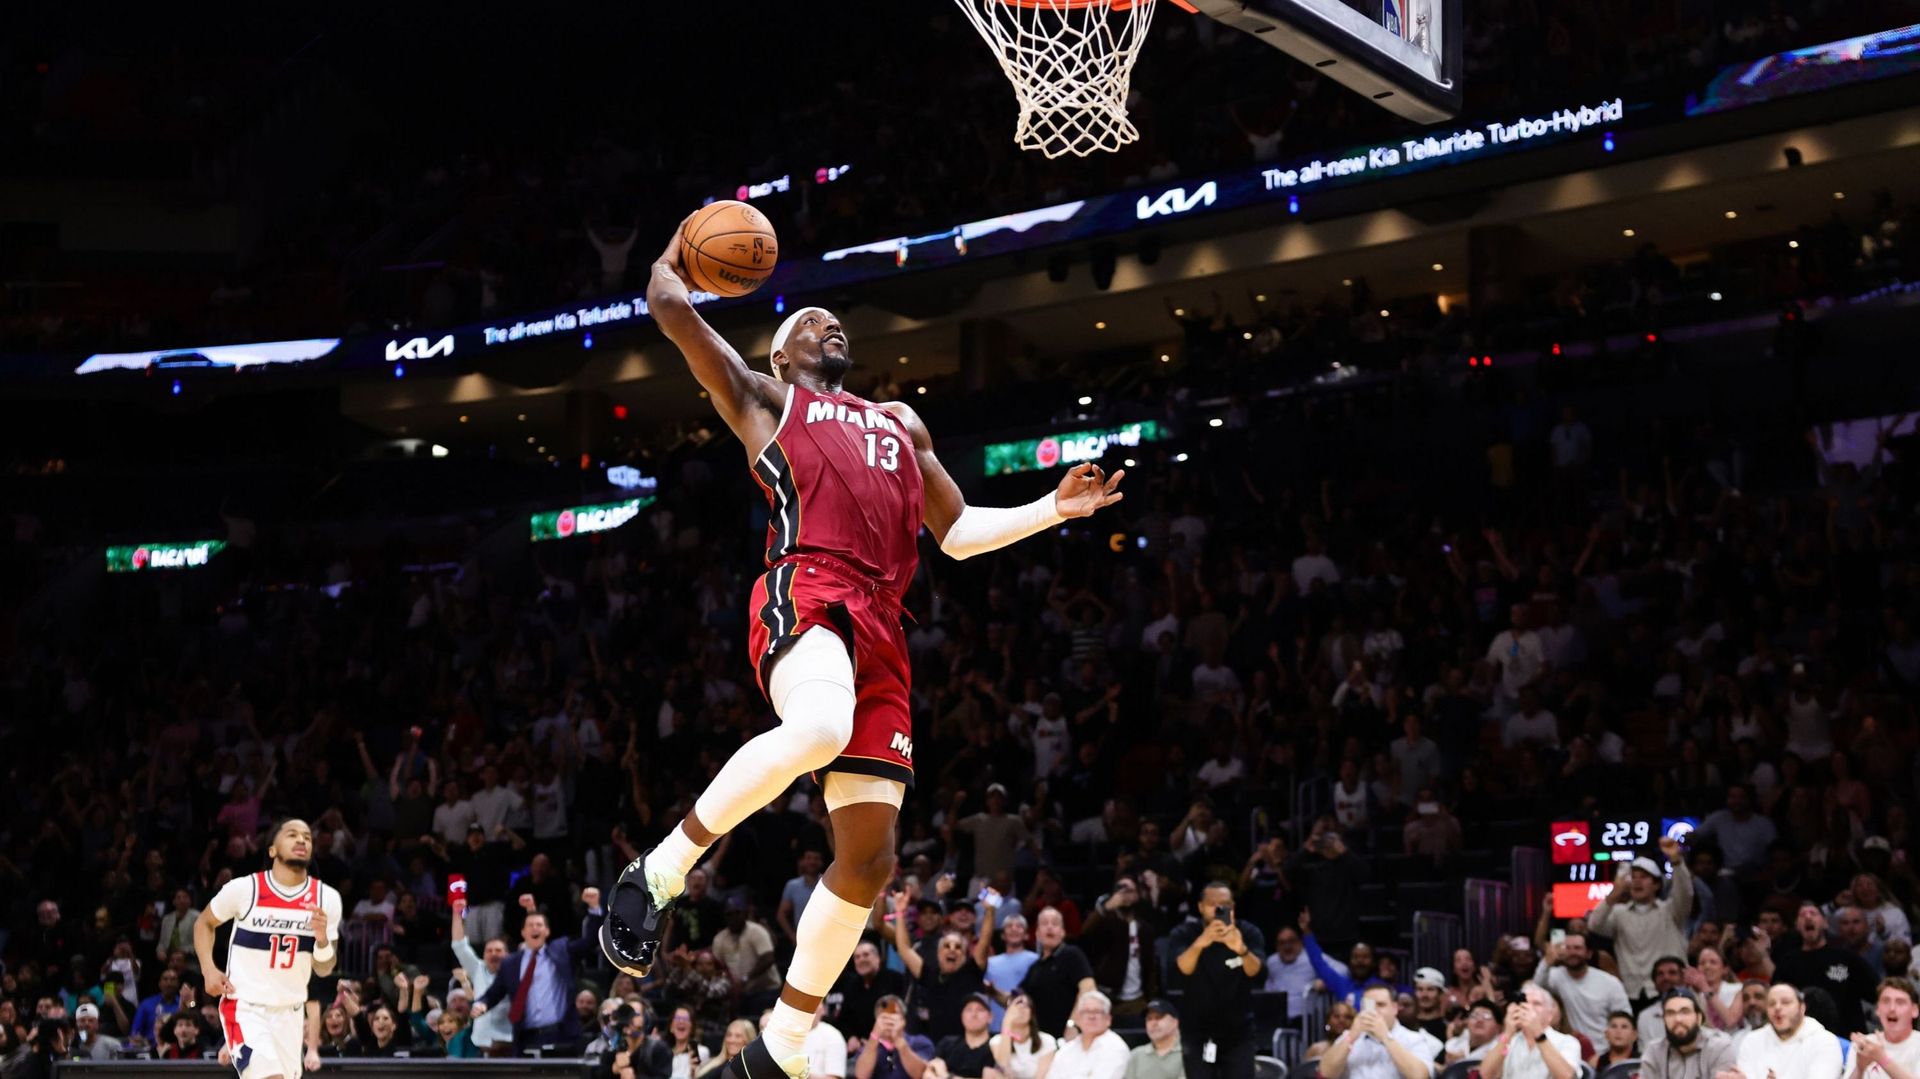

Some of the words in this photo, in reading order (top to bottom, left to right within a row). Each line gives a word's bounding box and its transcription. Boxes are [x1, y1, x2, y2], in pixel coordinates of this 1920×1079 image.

[1262, 168, 1298, 190] The
[1299, 155, 1366, 183] all-new
[1369, 147, 1400, 169] Kia
[1402, 130, 1484, 163] Telluride
[1487, 98, 1623, 144] Turbo-Hybrid
[484, 327, 507, 345] The
[508, 319, 554, 341] all-new
[554, 313, 577, 332] Kia
[577, 303, 631, 327] Telluride
[806, 400, 899, 434] MIAMI
[864, 432, 900, 473] 13
[1602, 821, 1649, 846] 22.9
[1569, 863, 1596, 881] 111
[269, 934, 299, 969] 13
